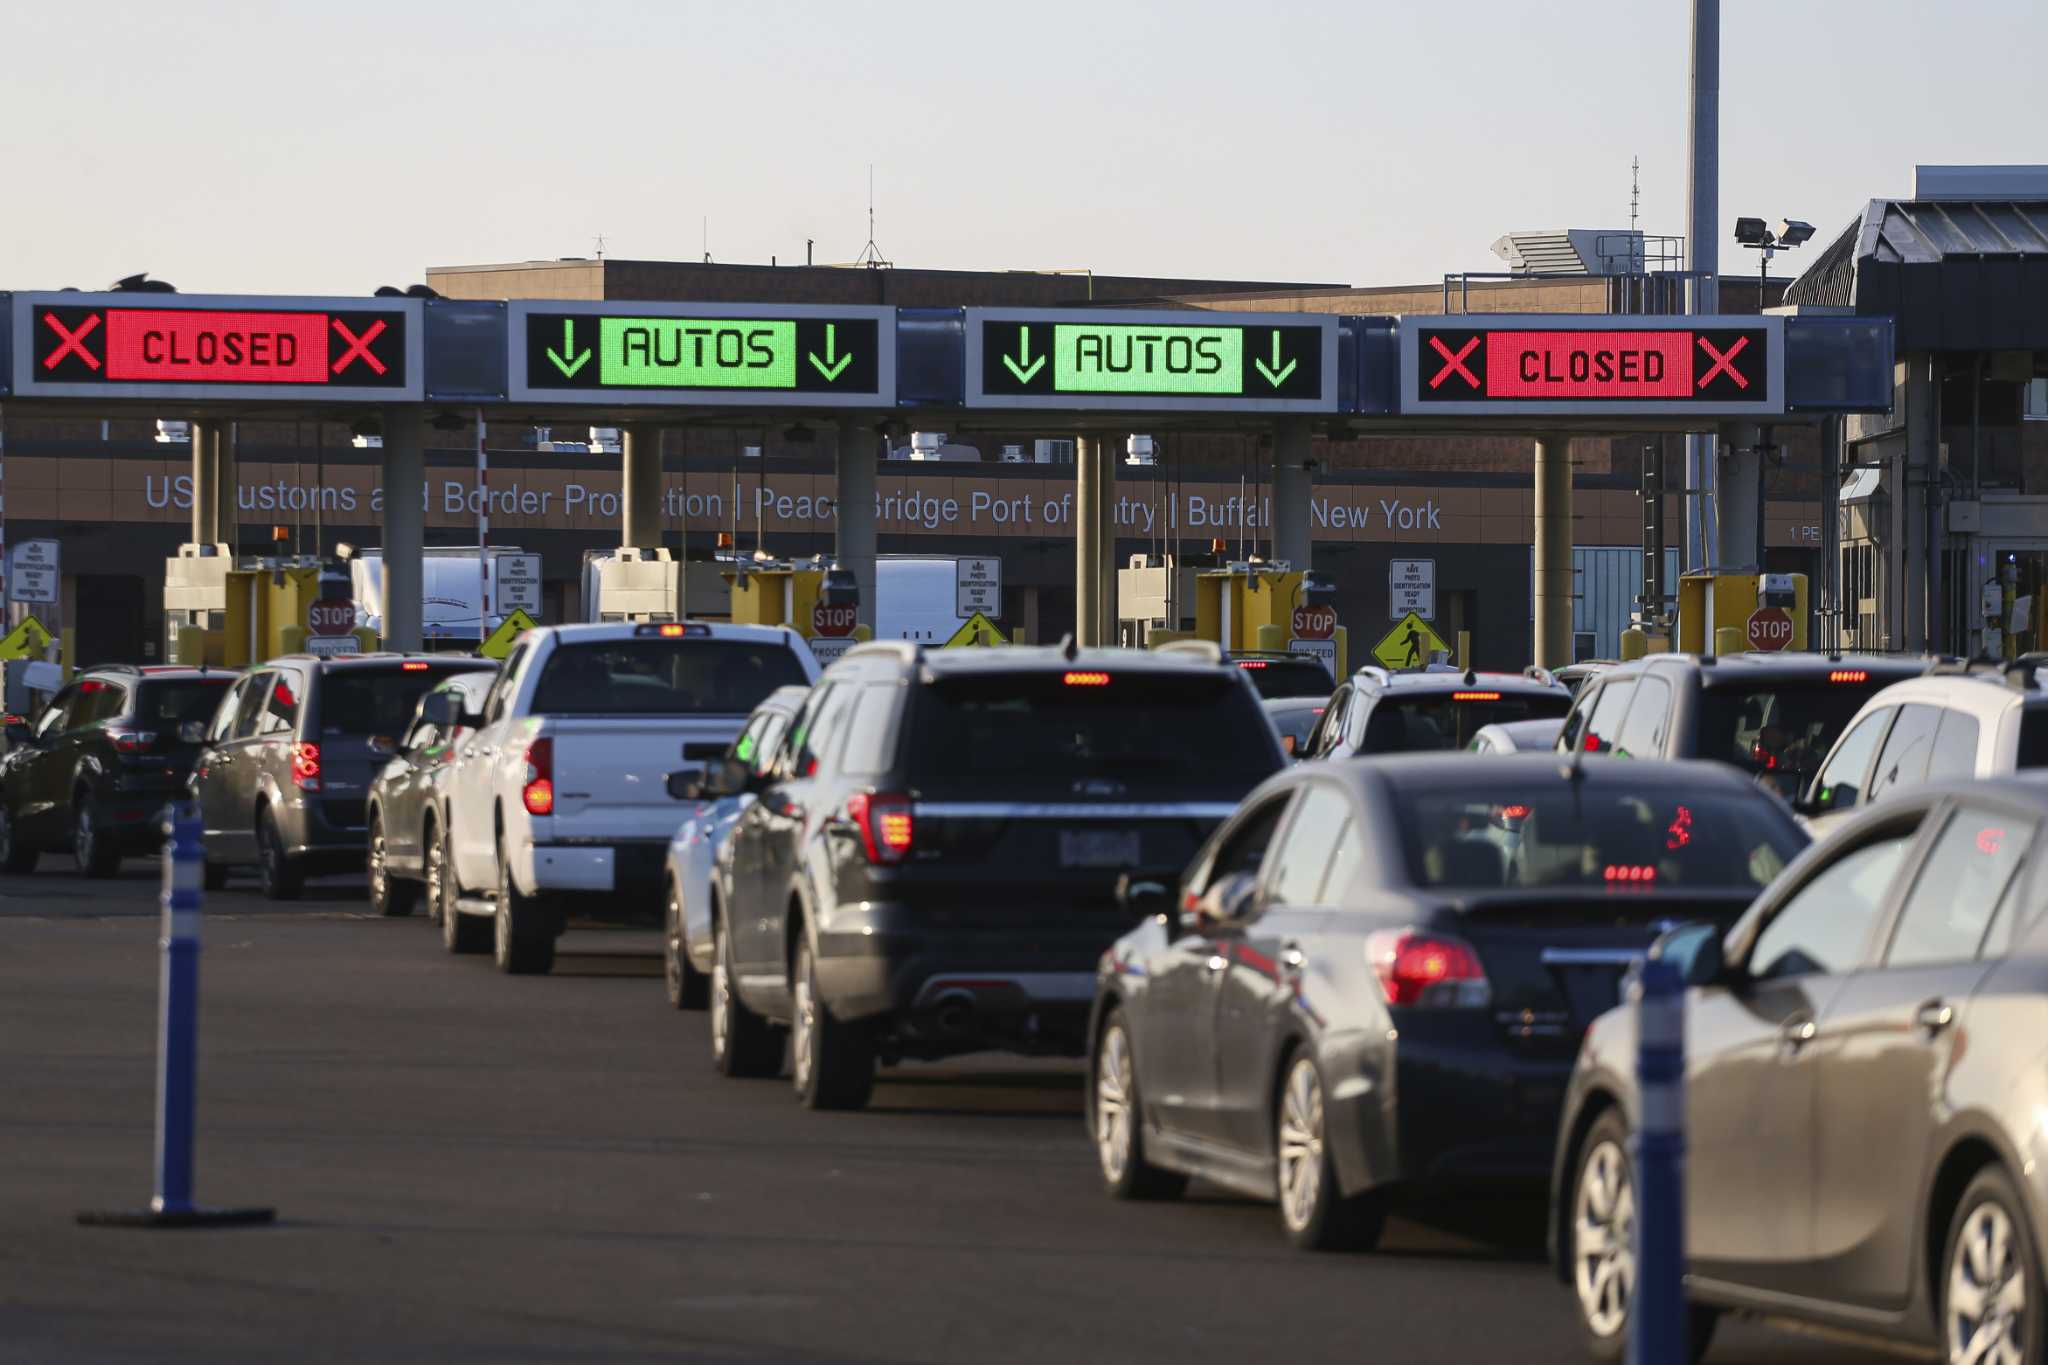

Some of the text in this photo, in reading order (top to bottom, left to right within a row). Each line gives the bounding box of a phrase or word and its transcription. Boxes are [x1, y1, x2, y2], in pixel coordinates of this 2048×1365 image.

[143, 331, 297, 366] CLOSED
[623, 328, 774, 368] AUTOS
[1076, 334, 1222, 374] AUTOS
[1519, 350, 1664, 382] CLOSED
[146, 475, 194, 508] US
[238, 480, 357, 512] ustoms
[445, 481, 552, 514] Border
[565, 484, 722, 516] Protion
[755, 487, 838, 519] Peac
[876, 489, 958, 529] ridge
[971, 491, 1032, 522] Port
[1043, 493, 1071, 522] of
[1113, 495, 1158, 532] try
[1188, 496, 1269, 527] Buffal
[1311, 498, 1369, 529] New
[1380, 500, 1441, 530] York
[311, 607, 353, 625] STOP
[815, 609, 854, 626] STOP
[1294, 612, 1333, 631] STOP
[1750, 621, 1791, 639] STOP
